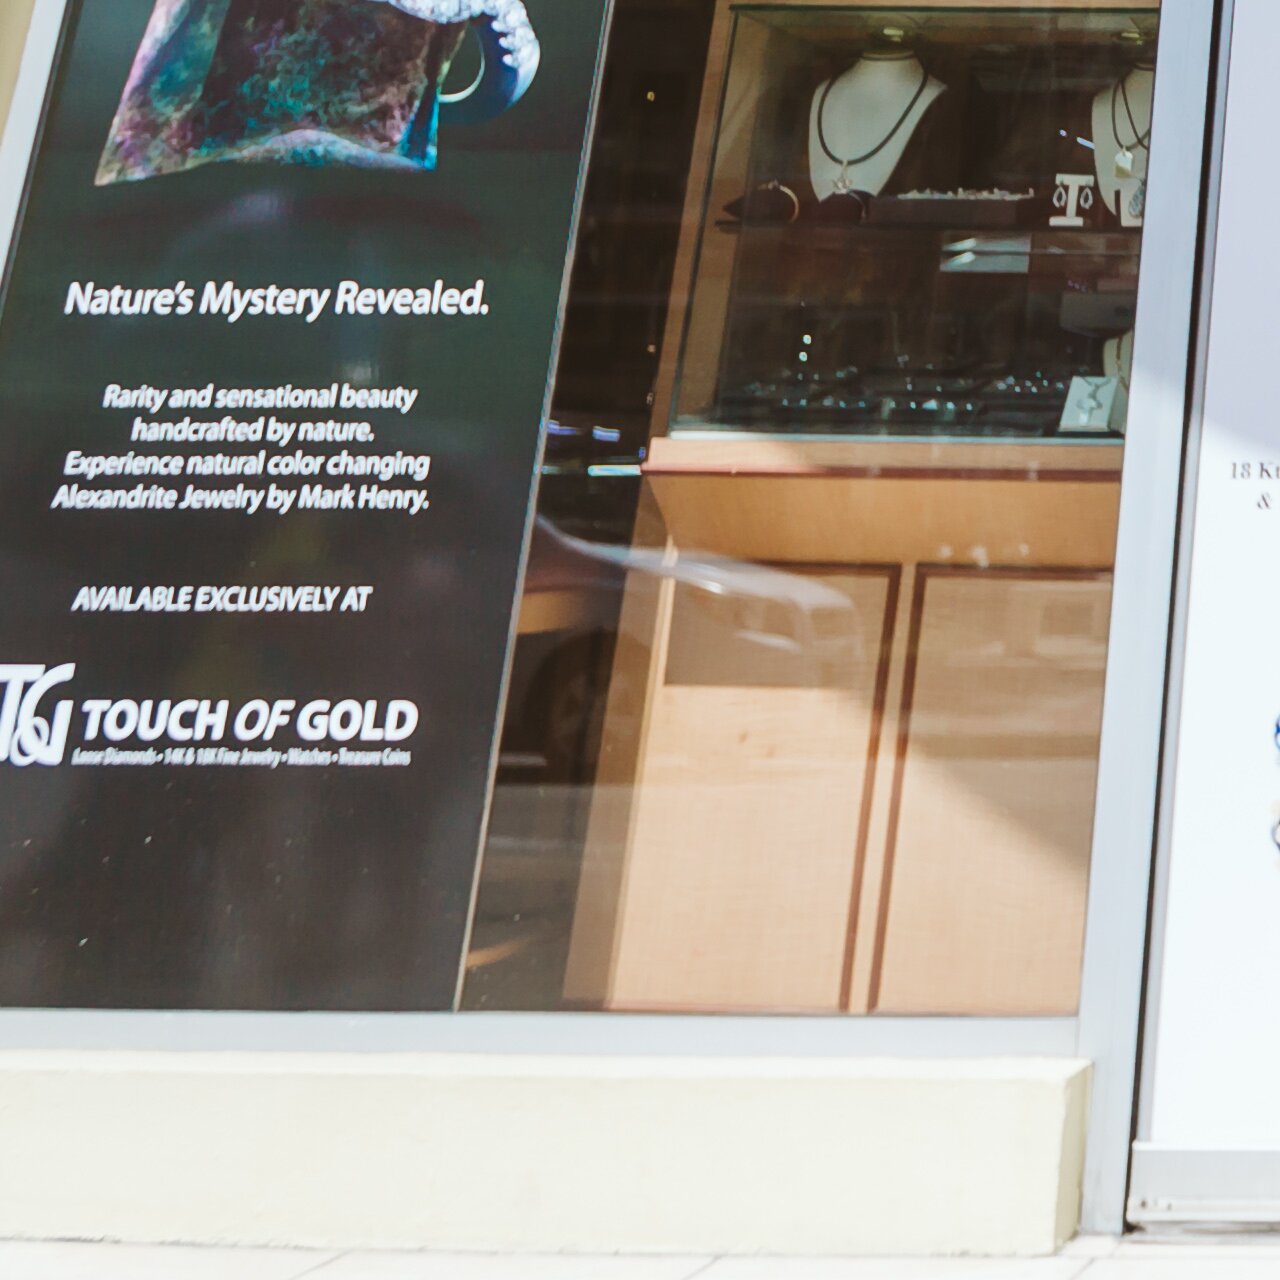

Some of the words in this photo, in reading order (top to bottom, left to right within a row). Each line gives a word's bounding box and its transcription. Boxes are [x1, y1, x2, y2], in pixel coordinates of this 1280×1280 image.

[199, 281, 331, 323] Mystery
[334, 279, 490, 316] Revealed.
[102, 384, 168, 413] Rarity
[168, 383, 214, 409] and
[214, 383, 338, 409] sensational
[339, 383, 418, 414] beauty
[130, 416, 265, 441] handcrafted
[265, 416, 297, 447] by
[298, 420, 375, 442] nature.
[64, 450, 185, 480] Experience
[185, 450, 266, 475] natural
[267, 450, 326, 475] color
[326, 450, 431, 481] changing
[1231, 462, 1252, 480] 18
[1259, 461, 1280, 480] Kt
[51, 484, 178, 509] Alexandrite
[178, 484, 266, 514] Jewelry
[266, 484, 298, 514] by
[299, 484, 355, 509] Mark
[358, 484, 430, 515] Henry.
[1256, 493, 1272, 510] &
[70, 586, 194, 612] AVAILABLE
[195, 586, 343, 612] EXCLUSIVELY
[339, 586, 373, 612] AT
[82, 699, 229, 741] TOUCH
[234, 699, 296, 741] OF
[297, 699, 418, 741] GOLD
